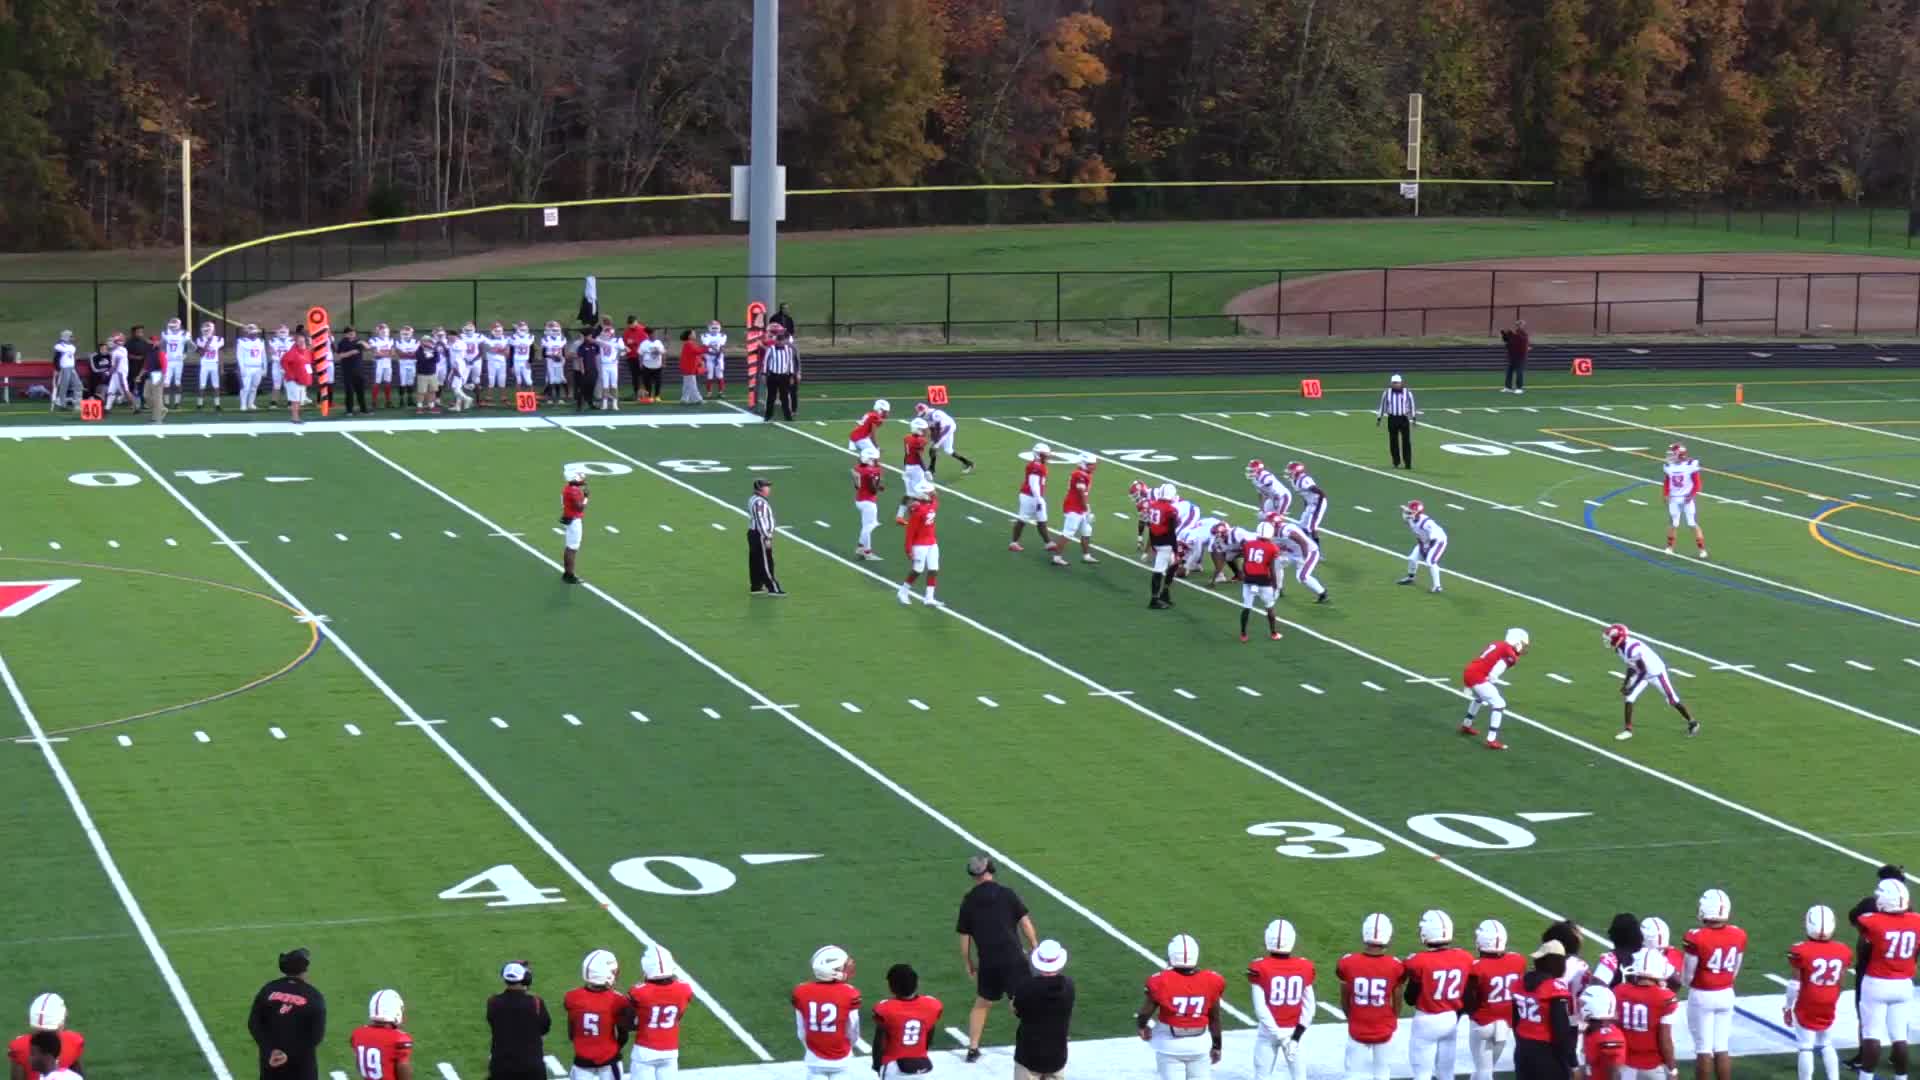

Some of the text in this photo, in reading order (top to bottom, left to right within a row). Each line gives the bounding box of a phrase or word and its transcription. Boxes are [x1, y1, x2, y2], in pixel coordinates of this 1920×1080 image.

[1577, 360, 1591, 373] G
[519, 395, 532, 409] 30
[930, 389, 945, 402] 20
[1304, 382, 1319, 396] 10
[83, 405, 99, 418] 40
[1248, 547, 1264, 563] 16
[1885, 930, 1916, 959] 70
[1707, 946, 1737, 974] 44
[1809, 958, 1843, 986] 23
[1269, 975, 1303, 1006] 80
[1354, 976, 1387, 1006] 95
[1432, 968, 1462, 1000] 72
[647, 1005, 678, 1029] 13
[808, 1001, 837, 1032] 12
[1172, 996, 1205, 1018] 77
[1622, 1001, 1649, 1032] 10
[583, 1012, 599, 1036] 5
[902, 1019, 921, 1045] 8
[357, 1045, 383, 1079] 19
